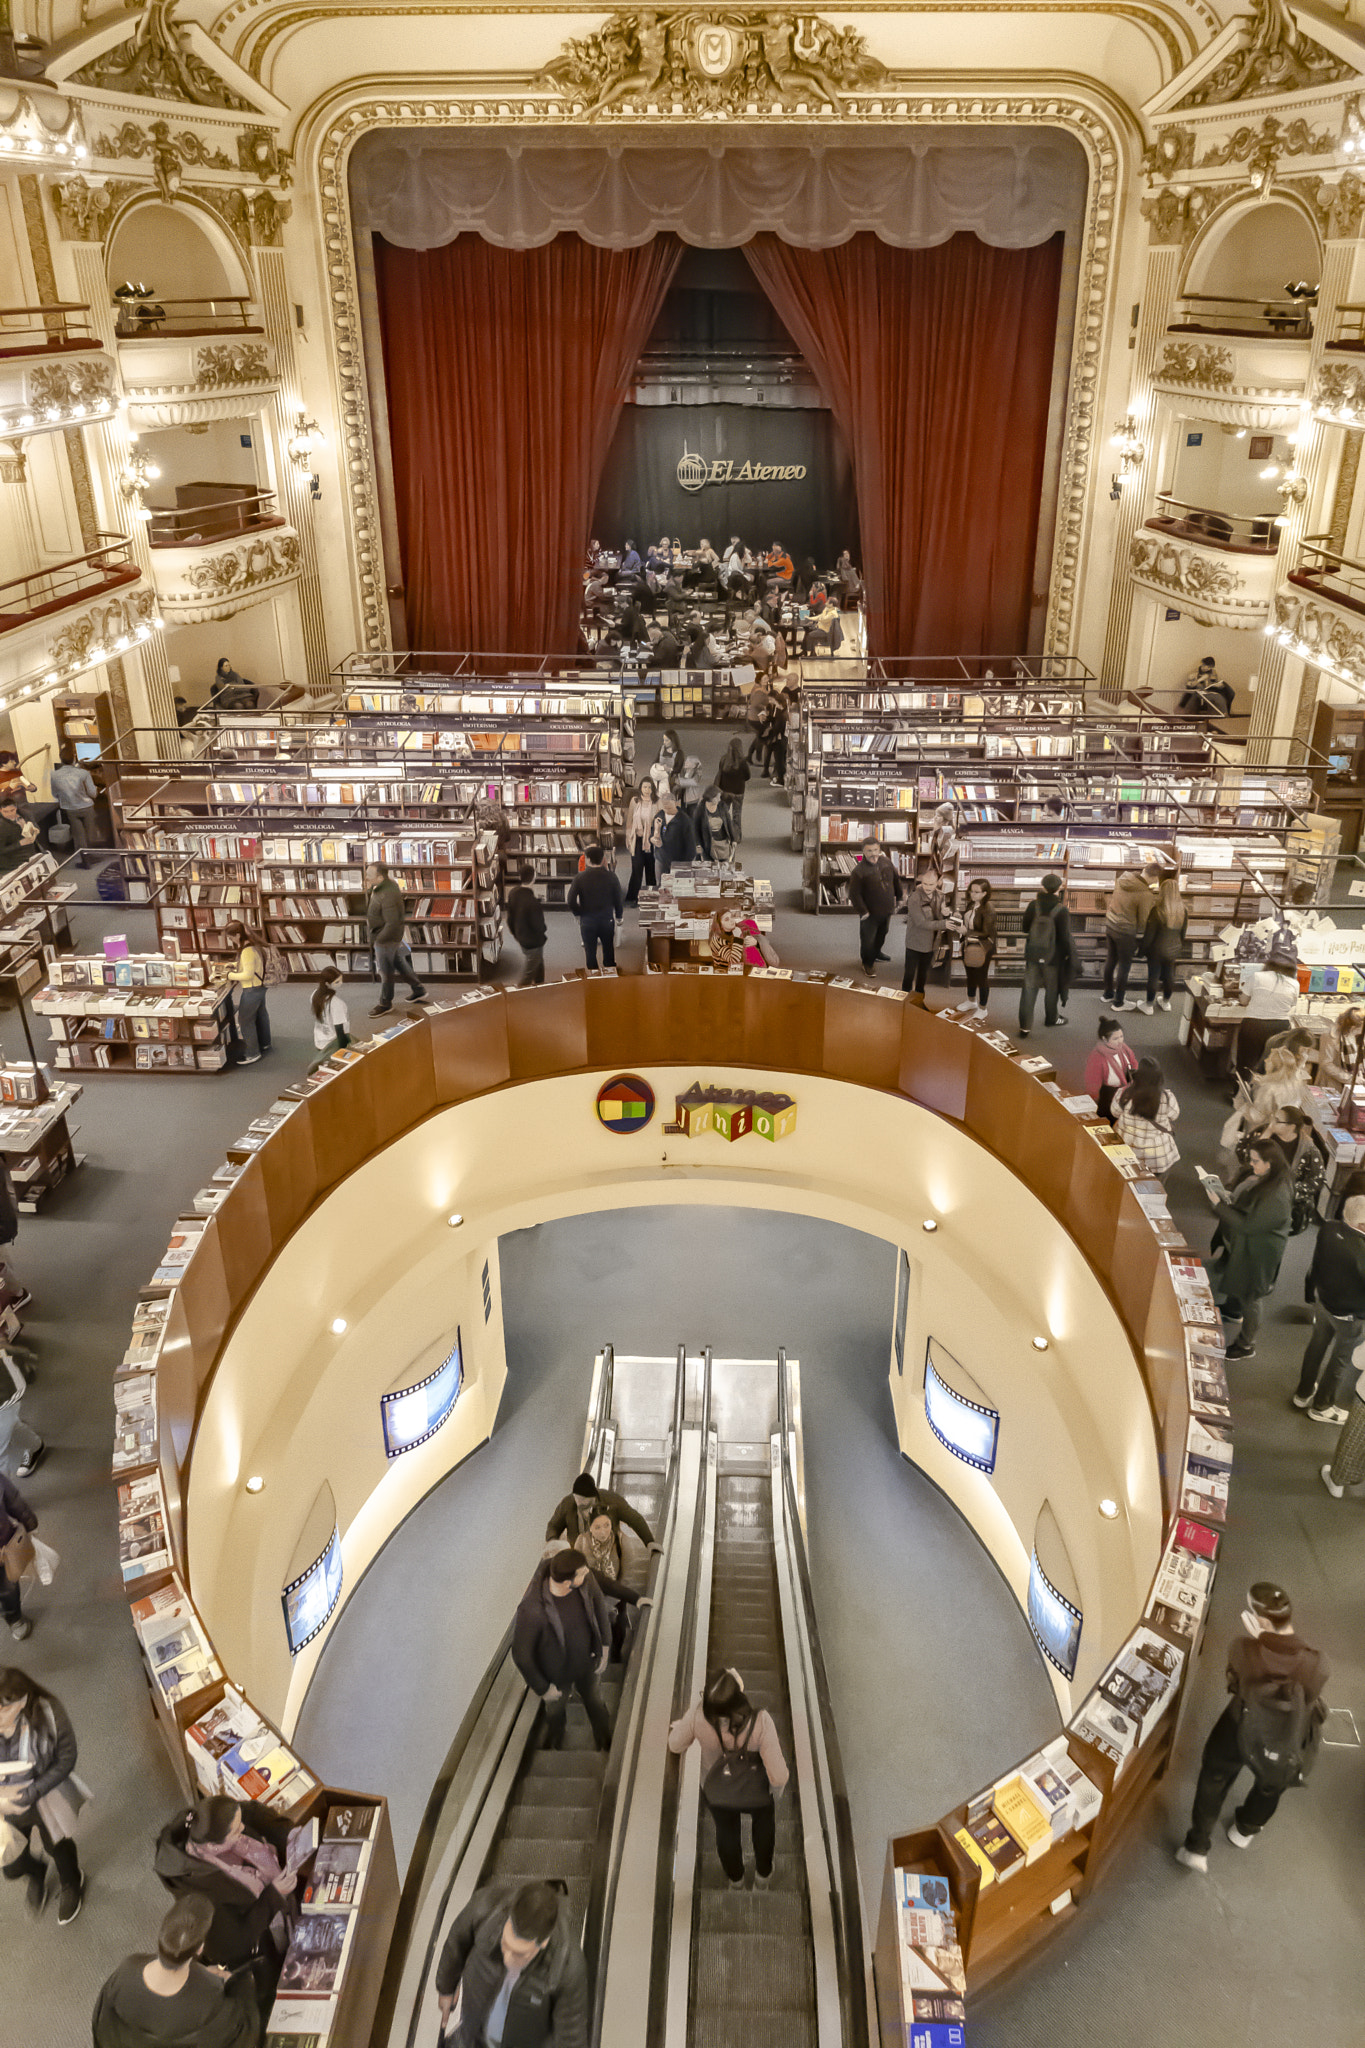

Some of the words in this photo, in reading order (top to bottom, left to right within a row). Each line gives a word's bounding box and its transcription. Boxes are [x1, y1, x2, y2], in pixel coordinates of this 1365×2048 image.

[708, 459, 734, 482] El
[735, 459, 807, 481] Ateneo
[680, 1080, 792, 1104] Ateneo
[676, 1105, 794, 1135] Junior
[1106, 1674, 1125, 1695] 24
